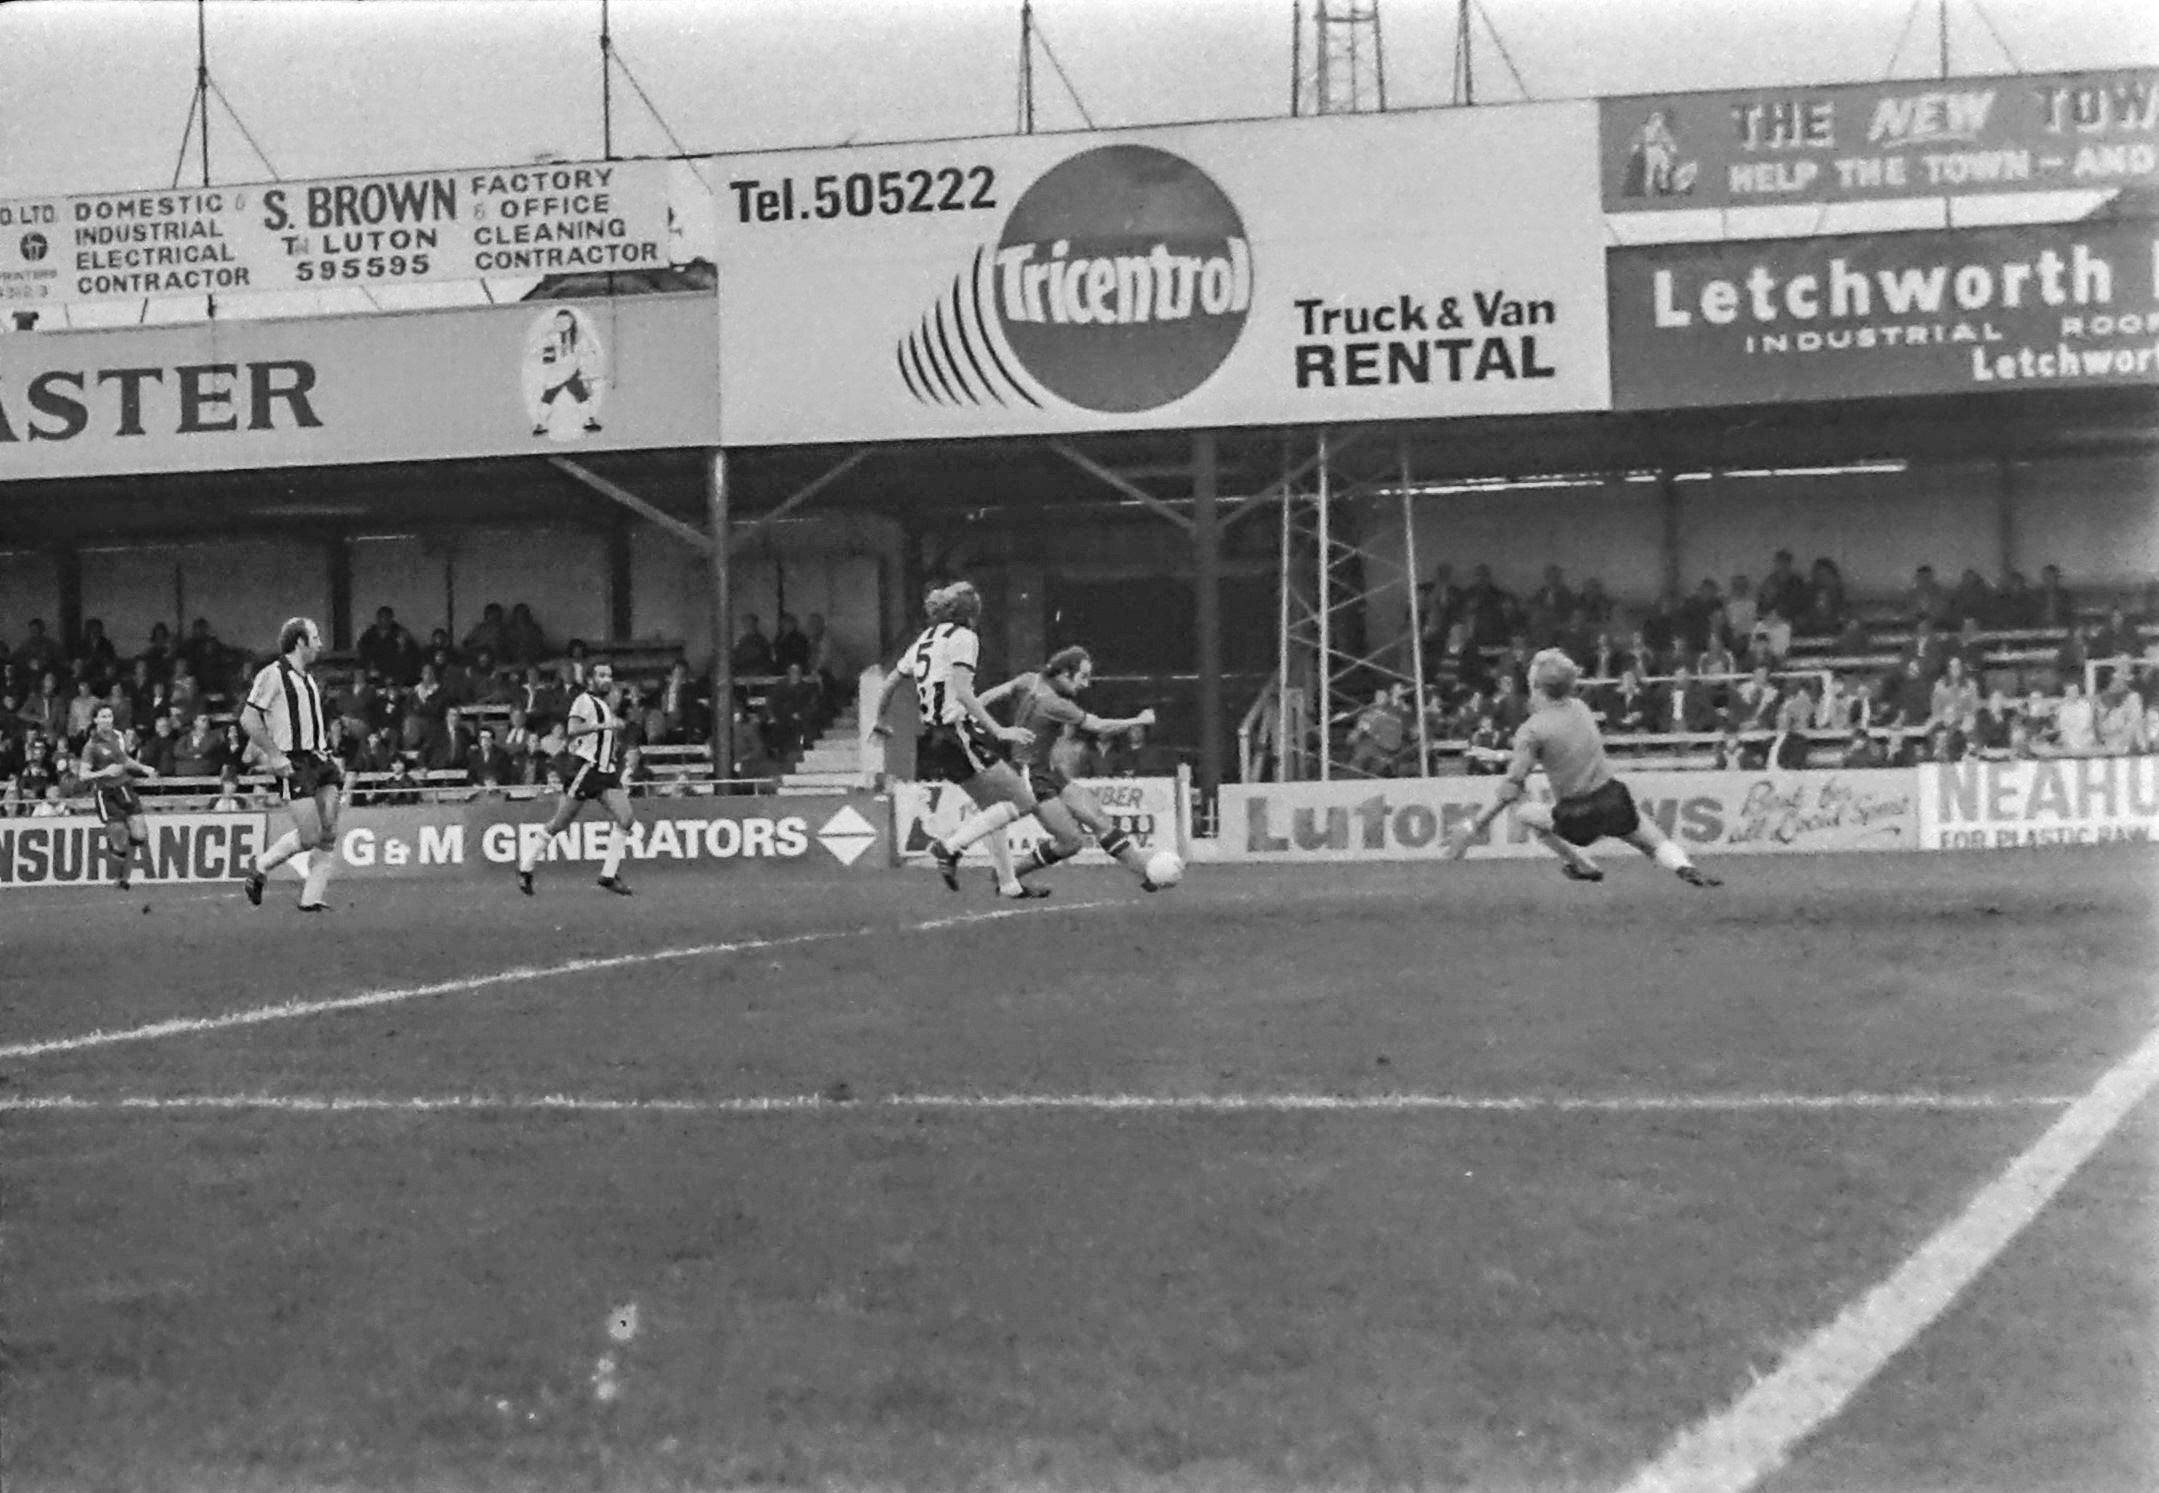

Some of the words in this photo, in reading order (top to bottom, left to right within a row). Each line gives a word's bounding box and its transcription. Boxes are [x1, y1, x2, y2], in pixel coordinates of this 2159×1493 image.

[1732, 100, 1836, 151] THE
[1866, 90, 1998, 148] NEW
[471, 167, 614, 195] FACTORY
[1729, 162, 1819, 193] HELP
[1834, 155, 1906, 188] THE
[1922, 149, 2030, 184] TOWN
[2072, 143, 2156, 178] AND
[75, 194, 223, 221] DOMESTIC
[308, 178, 456, 228] BROWN
[500, 193, 610, 218] OFFICE
[75, 220, 223, 246] INDUSTRIAL
[323, 228, 437, 253] LUTON
[473, 218, 626, 246] CLEANING
[76, 243, 235, 270] ELECTRICAL
[297, 254, 431, 281] 595595
[475, 242, 657, 271] CONTRACTOR
[78, 266, 250, 295] CONTRACTOR
[996, 236, 1252, 324] Tricentrol
[1654, 244, 2112, 328] Letchworth
[1294, 294, 1428, 335] Truck
[1436, 296, 1464, 331] &
[1473, 289, 1556, 328] Van
[1745, 322, 2003, 354] INDUSTRIAL
[1295, 335, 1556, 388] RENTAL
[915, 641, 931, 683] 5
[342, 827, 376, 867] G
[383, 838, 412, 866] &
[418, 825, 465, 865] M
[481, 816, 810, 865] GENERATORS
[1940, 829, 1987, 848] FOR
